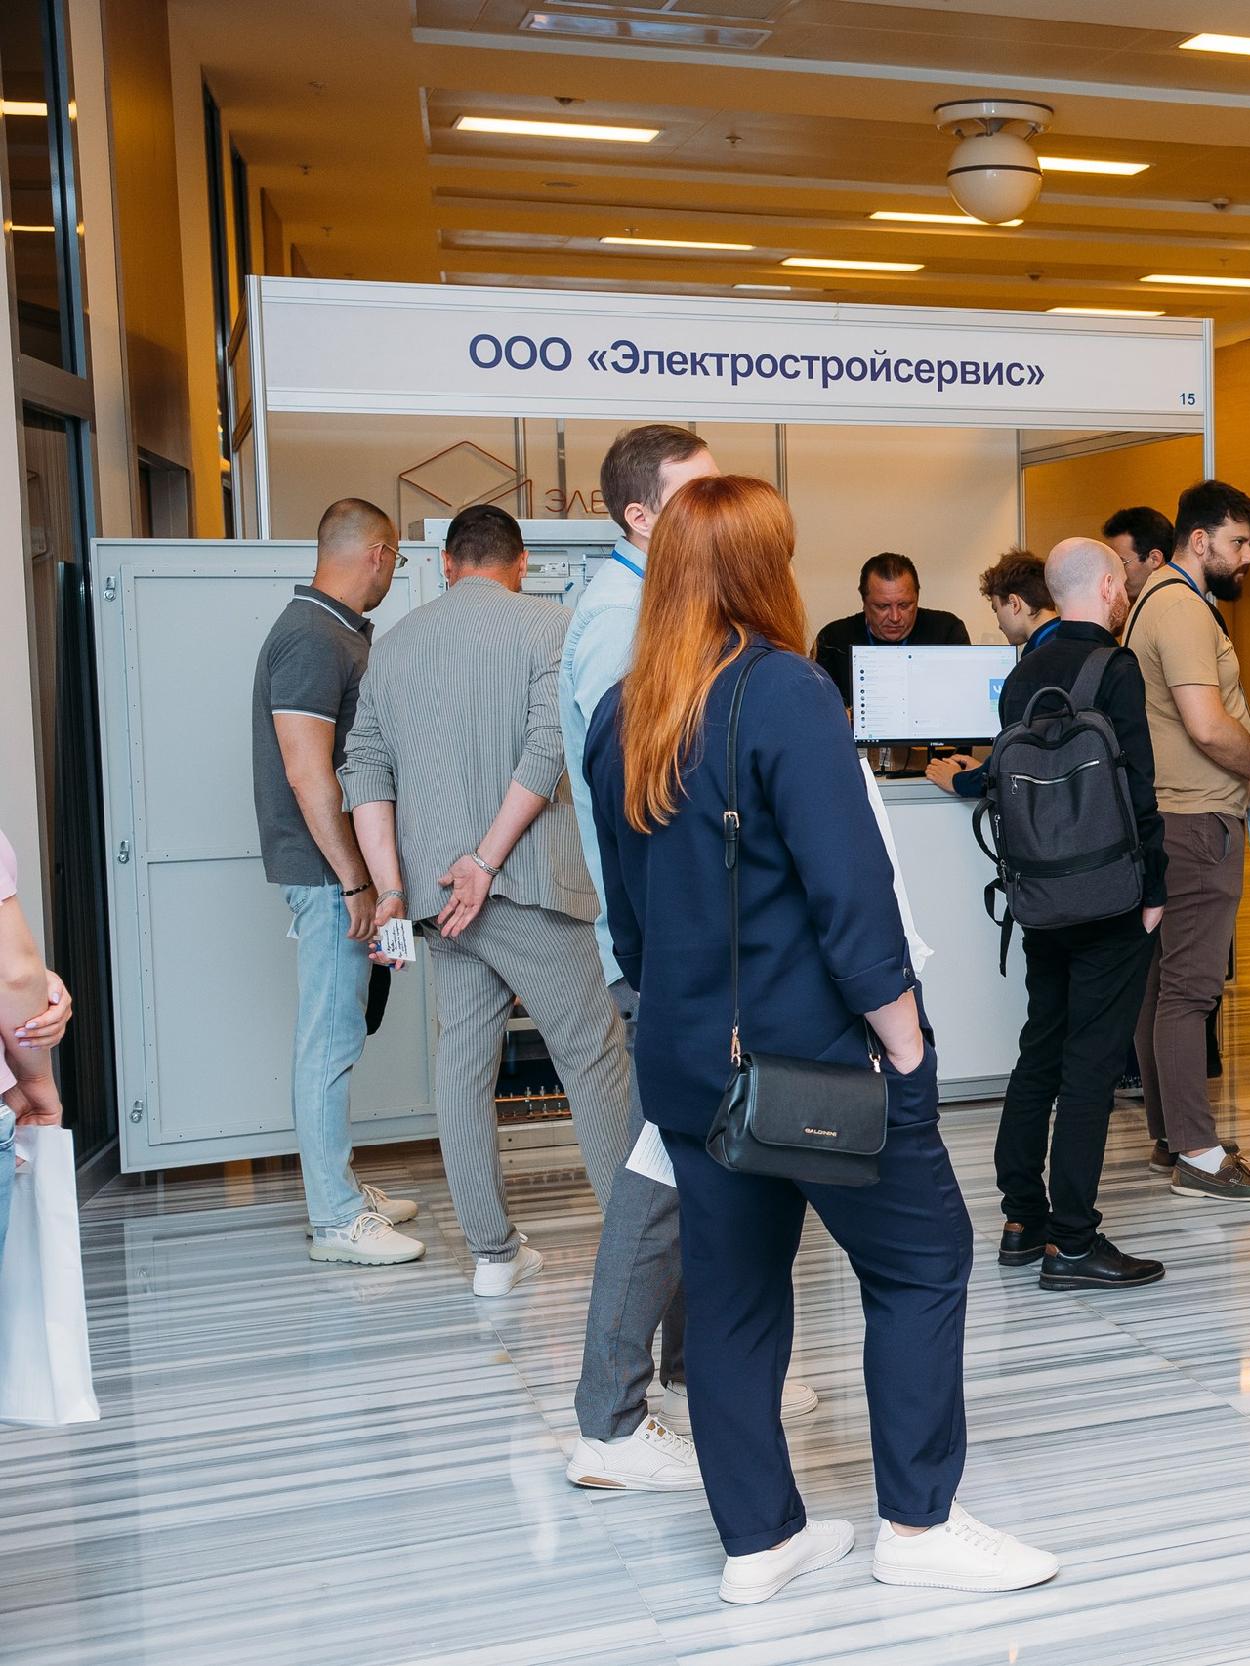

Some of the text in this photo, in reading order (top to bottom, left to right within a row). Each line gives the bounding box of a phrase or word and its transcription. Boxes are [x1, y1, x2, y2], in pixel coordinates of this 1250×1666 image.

[469, 333, 1046, 393] ООО «Электростройсервис»
[1180, 392, 1195, 405] 15
